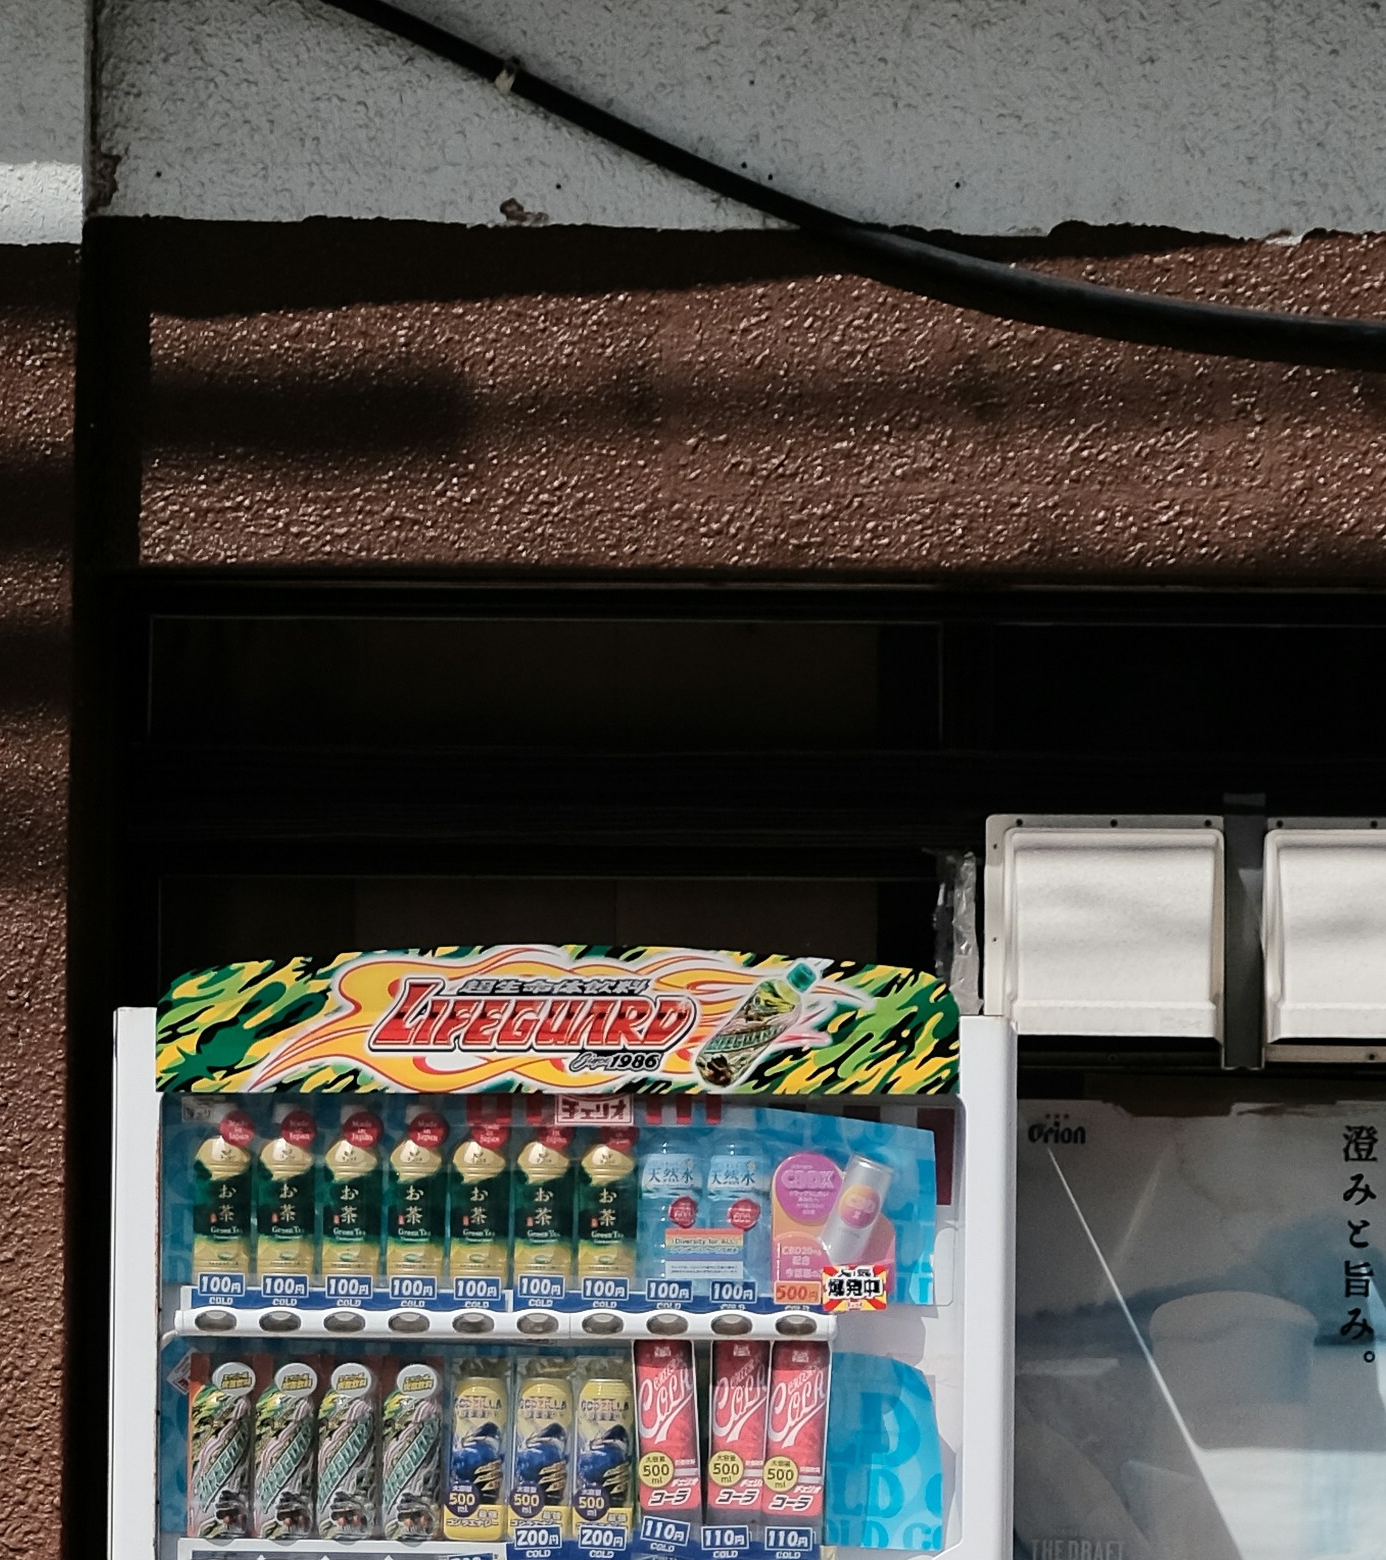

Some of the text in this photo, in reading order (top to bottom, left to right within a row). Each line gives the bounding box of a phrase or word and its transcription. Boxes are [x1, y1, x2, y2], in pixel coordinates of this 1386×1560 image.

[370, 977, 697, 1051] LIFEGUARD
[609, 1052, 662, 1072] 1986
[562, 1100, 627, 1121] チェリオ
[1028, 1121, 1086, 1144] Orion
[648, 1167, 694, 1185] 天然水
[711, 1168, 756, 1187] 天然水
[218, 1183, 237, 1222] お茶
[279, 1183, 298, 1223] お茶
[340, 1184, 359, 1225] お茶
[405, 1185, 424, 1225] お茶
[1340, 1124, 1379, 1365] 澄みと旨み。
[201, 1275, 242, 1294] 100円
[265, 1277, 306, 1295] 100円
[329, 1278, 370, 1296] 100円
[393, 1279, 433, 1297] 100円
[457, 1279, 498, 1297] 100円
[521, 1277, 562, 1296] 100円
[584, 1280, 625, 1298] 100円
[776, 1285, 819, 1301] 500円
[208, 1296, 234, 1307] COLD
[272, 1297, 298, 1307] COLD
[336, 1298, 362, 1308] COLD
[400, 1299, 425, 1308] COLD
[464, 1300, 490, 1309] COLD
[642, 1464, 670, 1477] 500
[712, 1463, 740, 1476] 500
[651, 1475, 663, 1485] ml
[448, 1493, 476, 1506] 500
[513, 1494, 540, 1507] 500
[649, 1489, 691, 1506] コーラ
[716, 1489, 759, 1506] コーラ
[769, 1495, 812, 1511] コーラ
[516, 1528, 559, 1547] 200円
[580, 1530, 624, 1548] 200円
[643, 1519, 685, 1542] 110円
[704, 1529, 745, 1547] 110円
[768, 1530, 809, 1547] 110円
